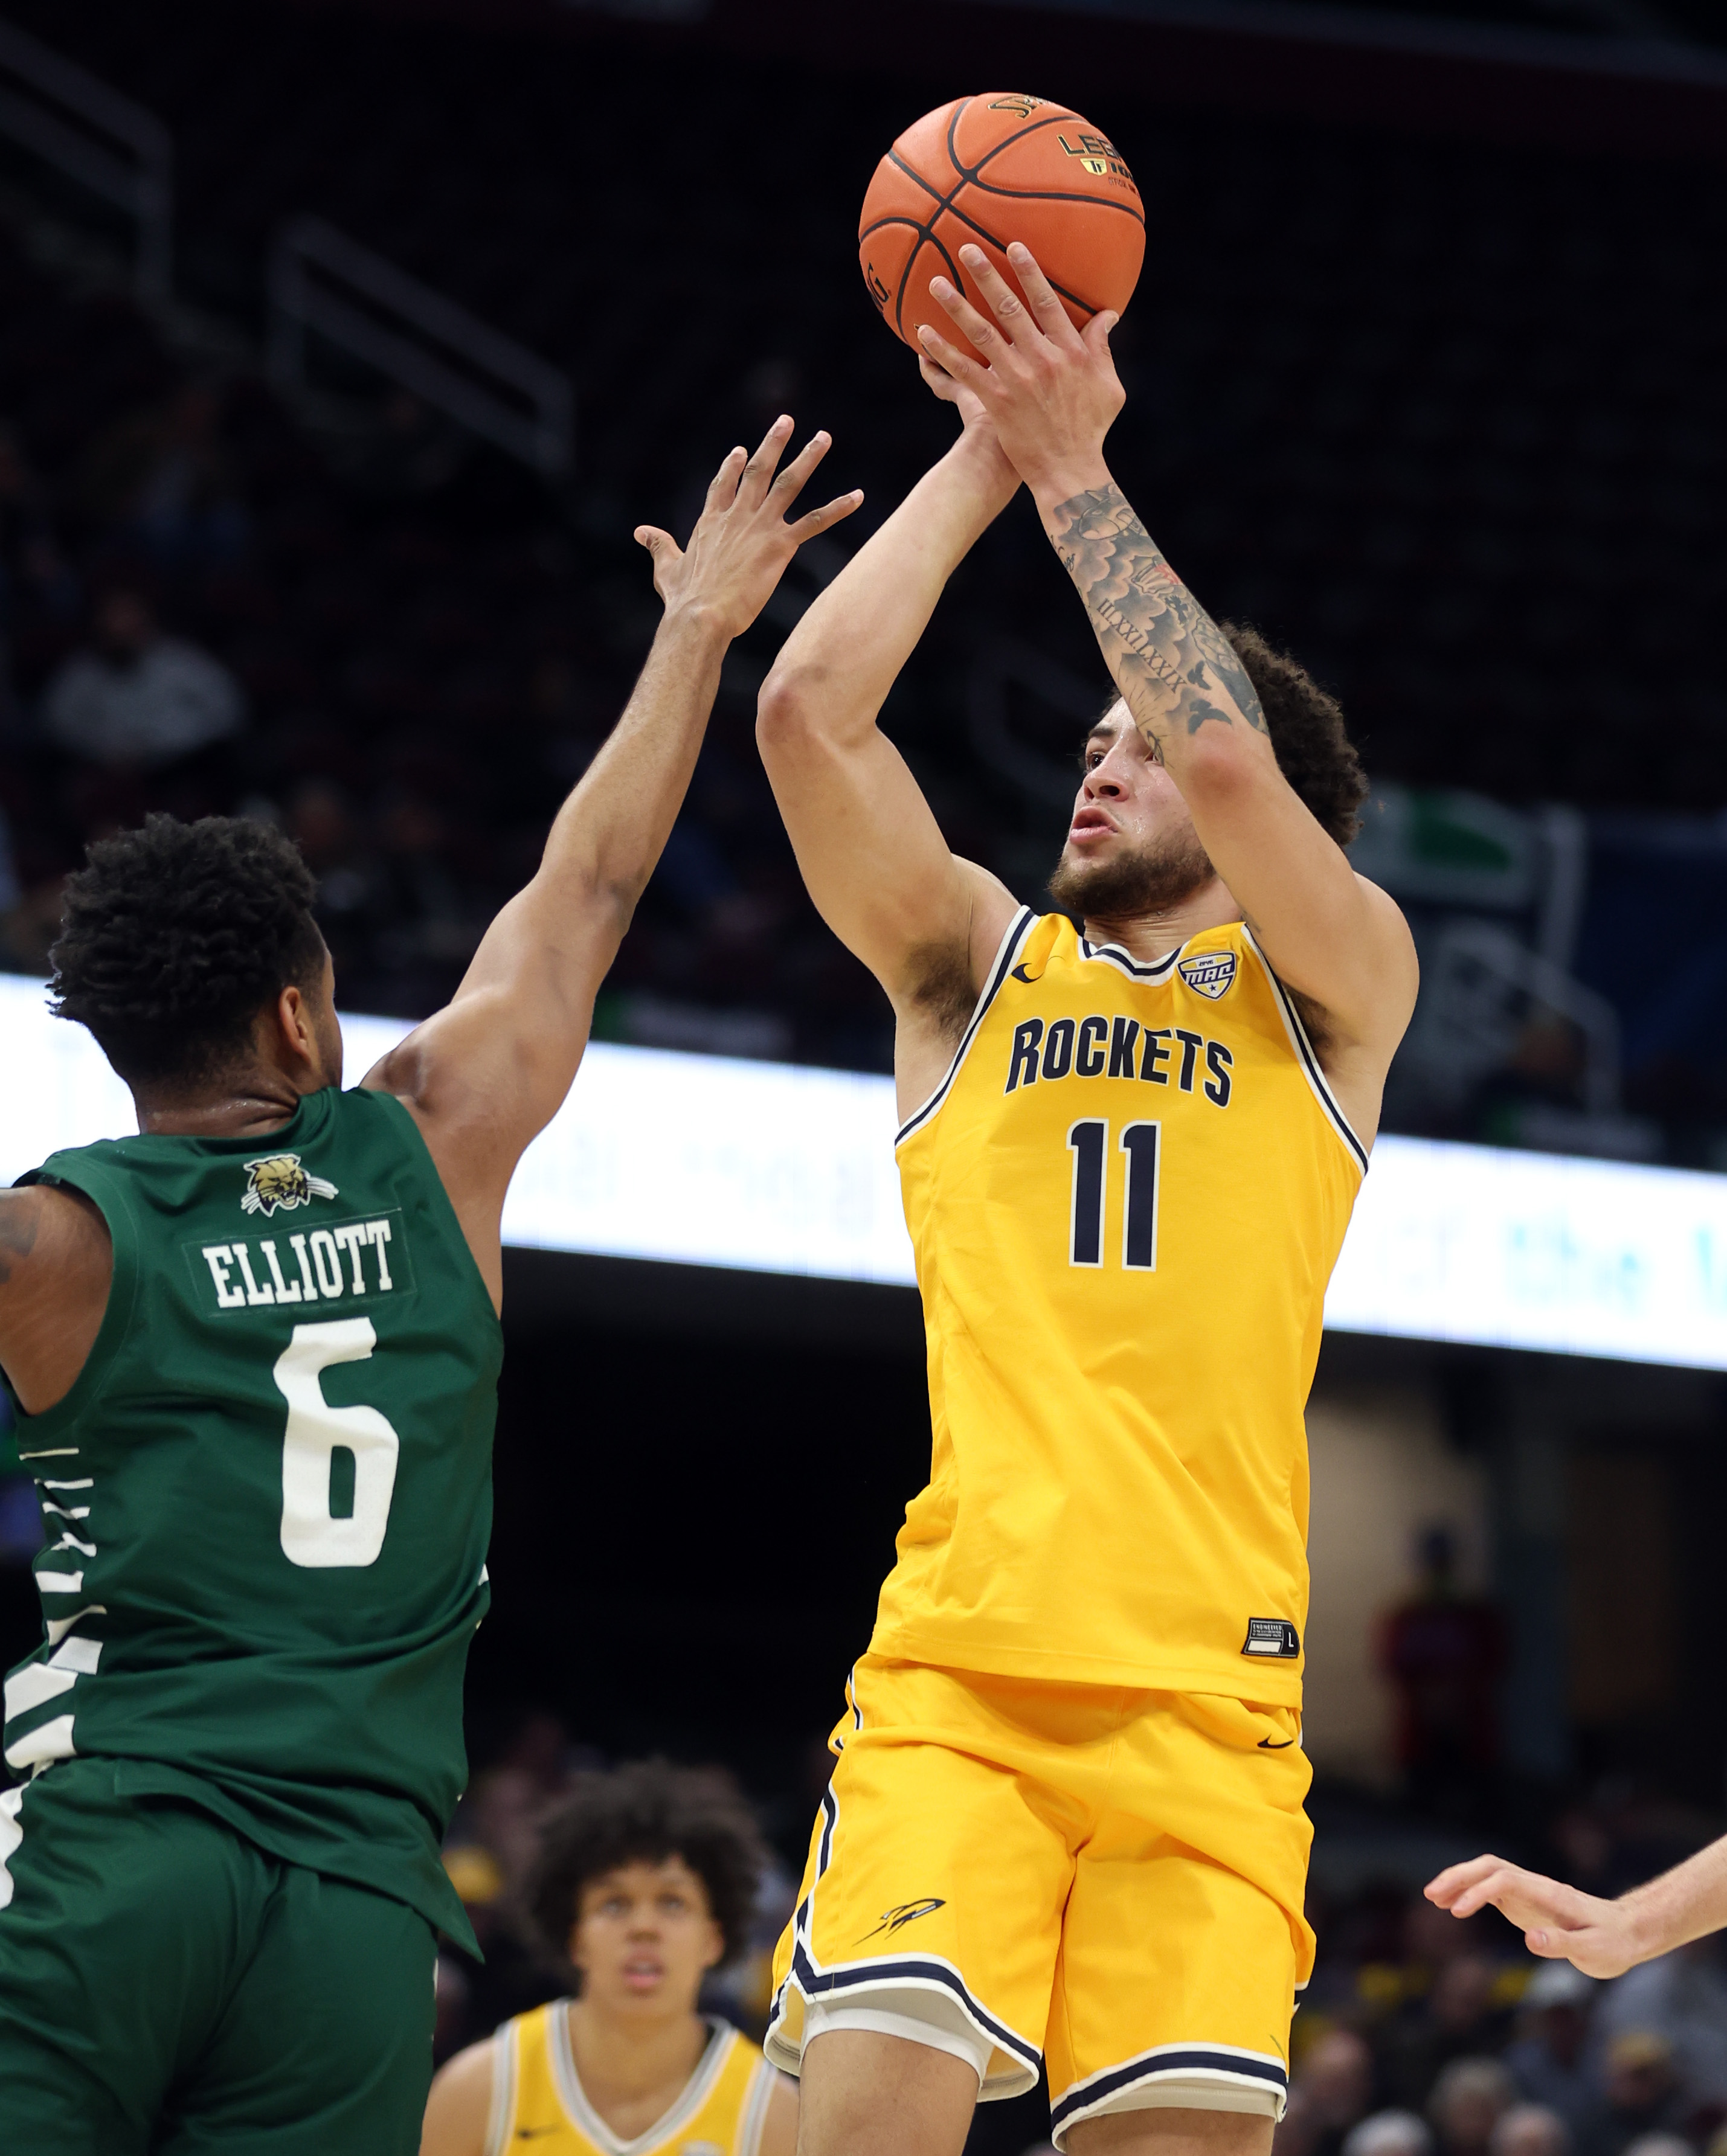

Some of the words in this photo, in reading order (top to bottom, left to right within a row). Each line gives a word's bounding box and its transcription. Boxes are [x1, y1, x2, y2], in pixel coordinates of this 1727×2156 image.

[1185, 963, 1233, 985] MAC
[1003, 1015, 1233, 1109] ROCKETS
[1066, 1117, 1162, 1272] 11
[202, 1219, 393, 1309] ELLIOTT
[273, 1317, 399, 1568] 6
[1288, 1632, 1294, 1647] L
